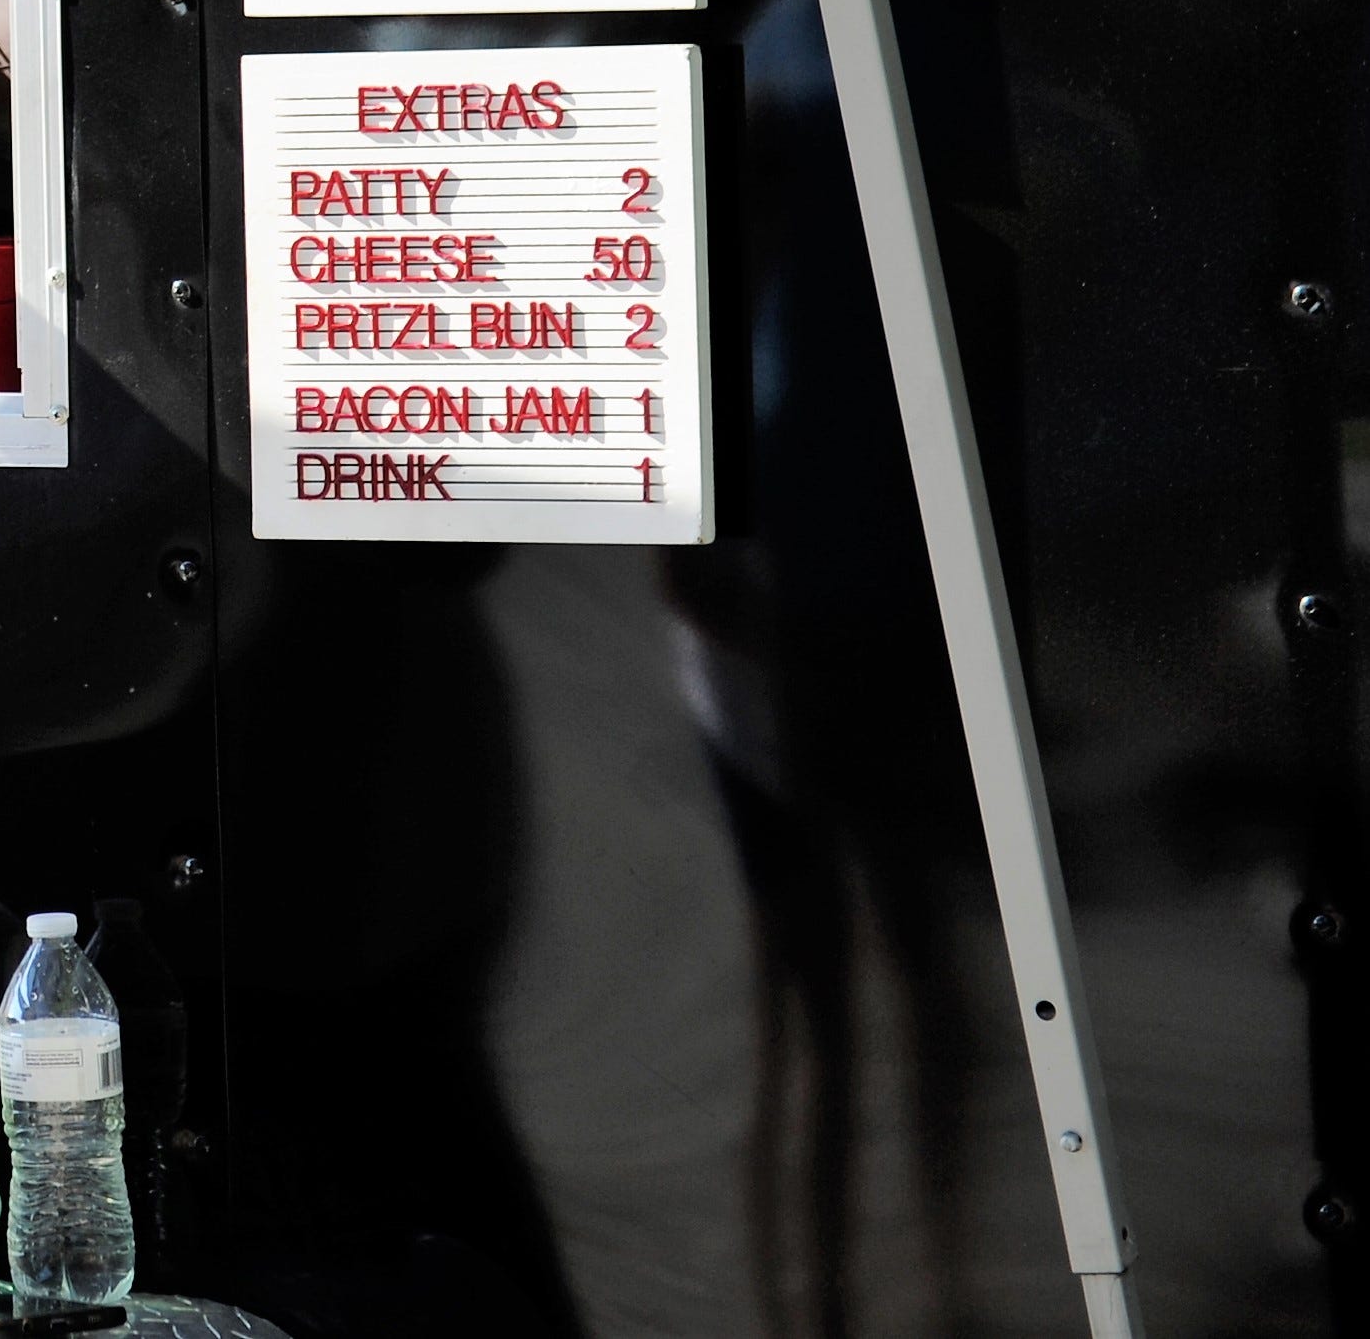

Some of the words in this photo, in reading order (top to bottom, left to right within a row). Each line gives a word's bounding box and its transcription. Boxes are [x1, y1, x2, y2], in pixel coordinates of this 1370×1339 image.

[358, 80, 566, 134] EXTRAS
[290, 169, 450, 217] PATTY
[621, 168, 652, 214] 2
[290, 235, 499, 285] CHEESE
[583, 235, 652, 283] .50
[295, 303, 458, 351] PRTZL
[470, 302, 573, 351] BUN
[626, 304, 658, 351] 2
[295, 386, 470, 434] BACON
[489, 385, 591, 435] JAM
[633, 388, 652, 435] 1
[296, 453, 453, 503] DRINK
[632, 457, 651, 504] 1
